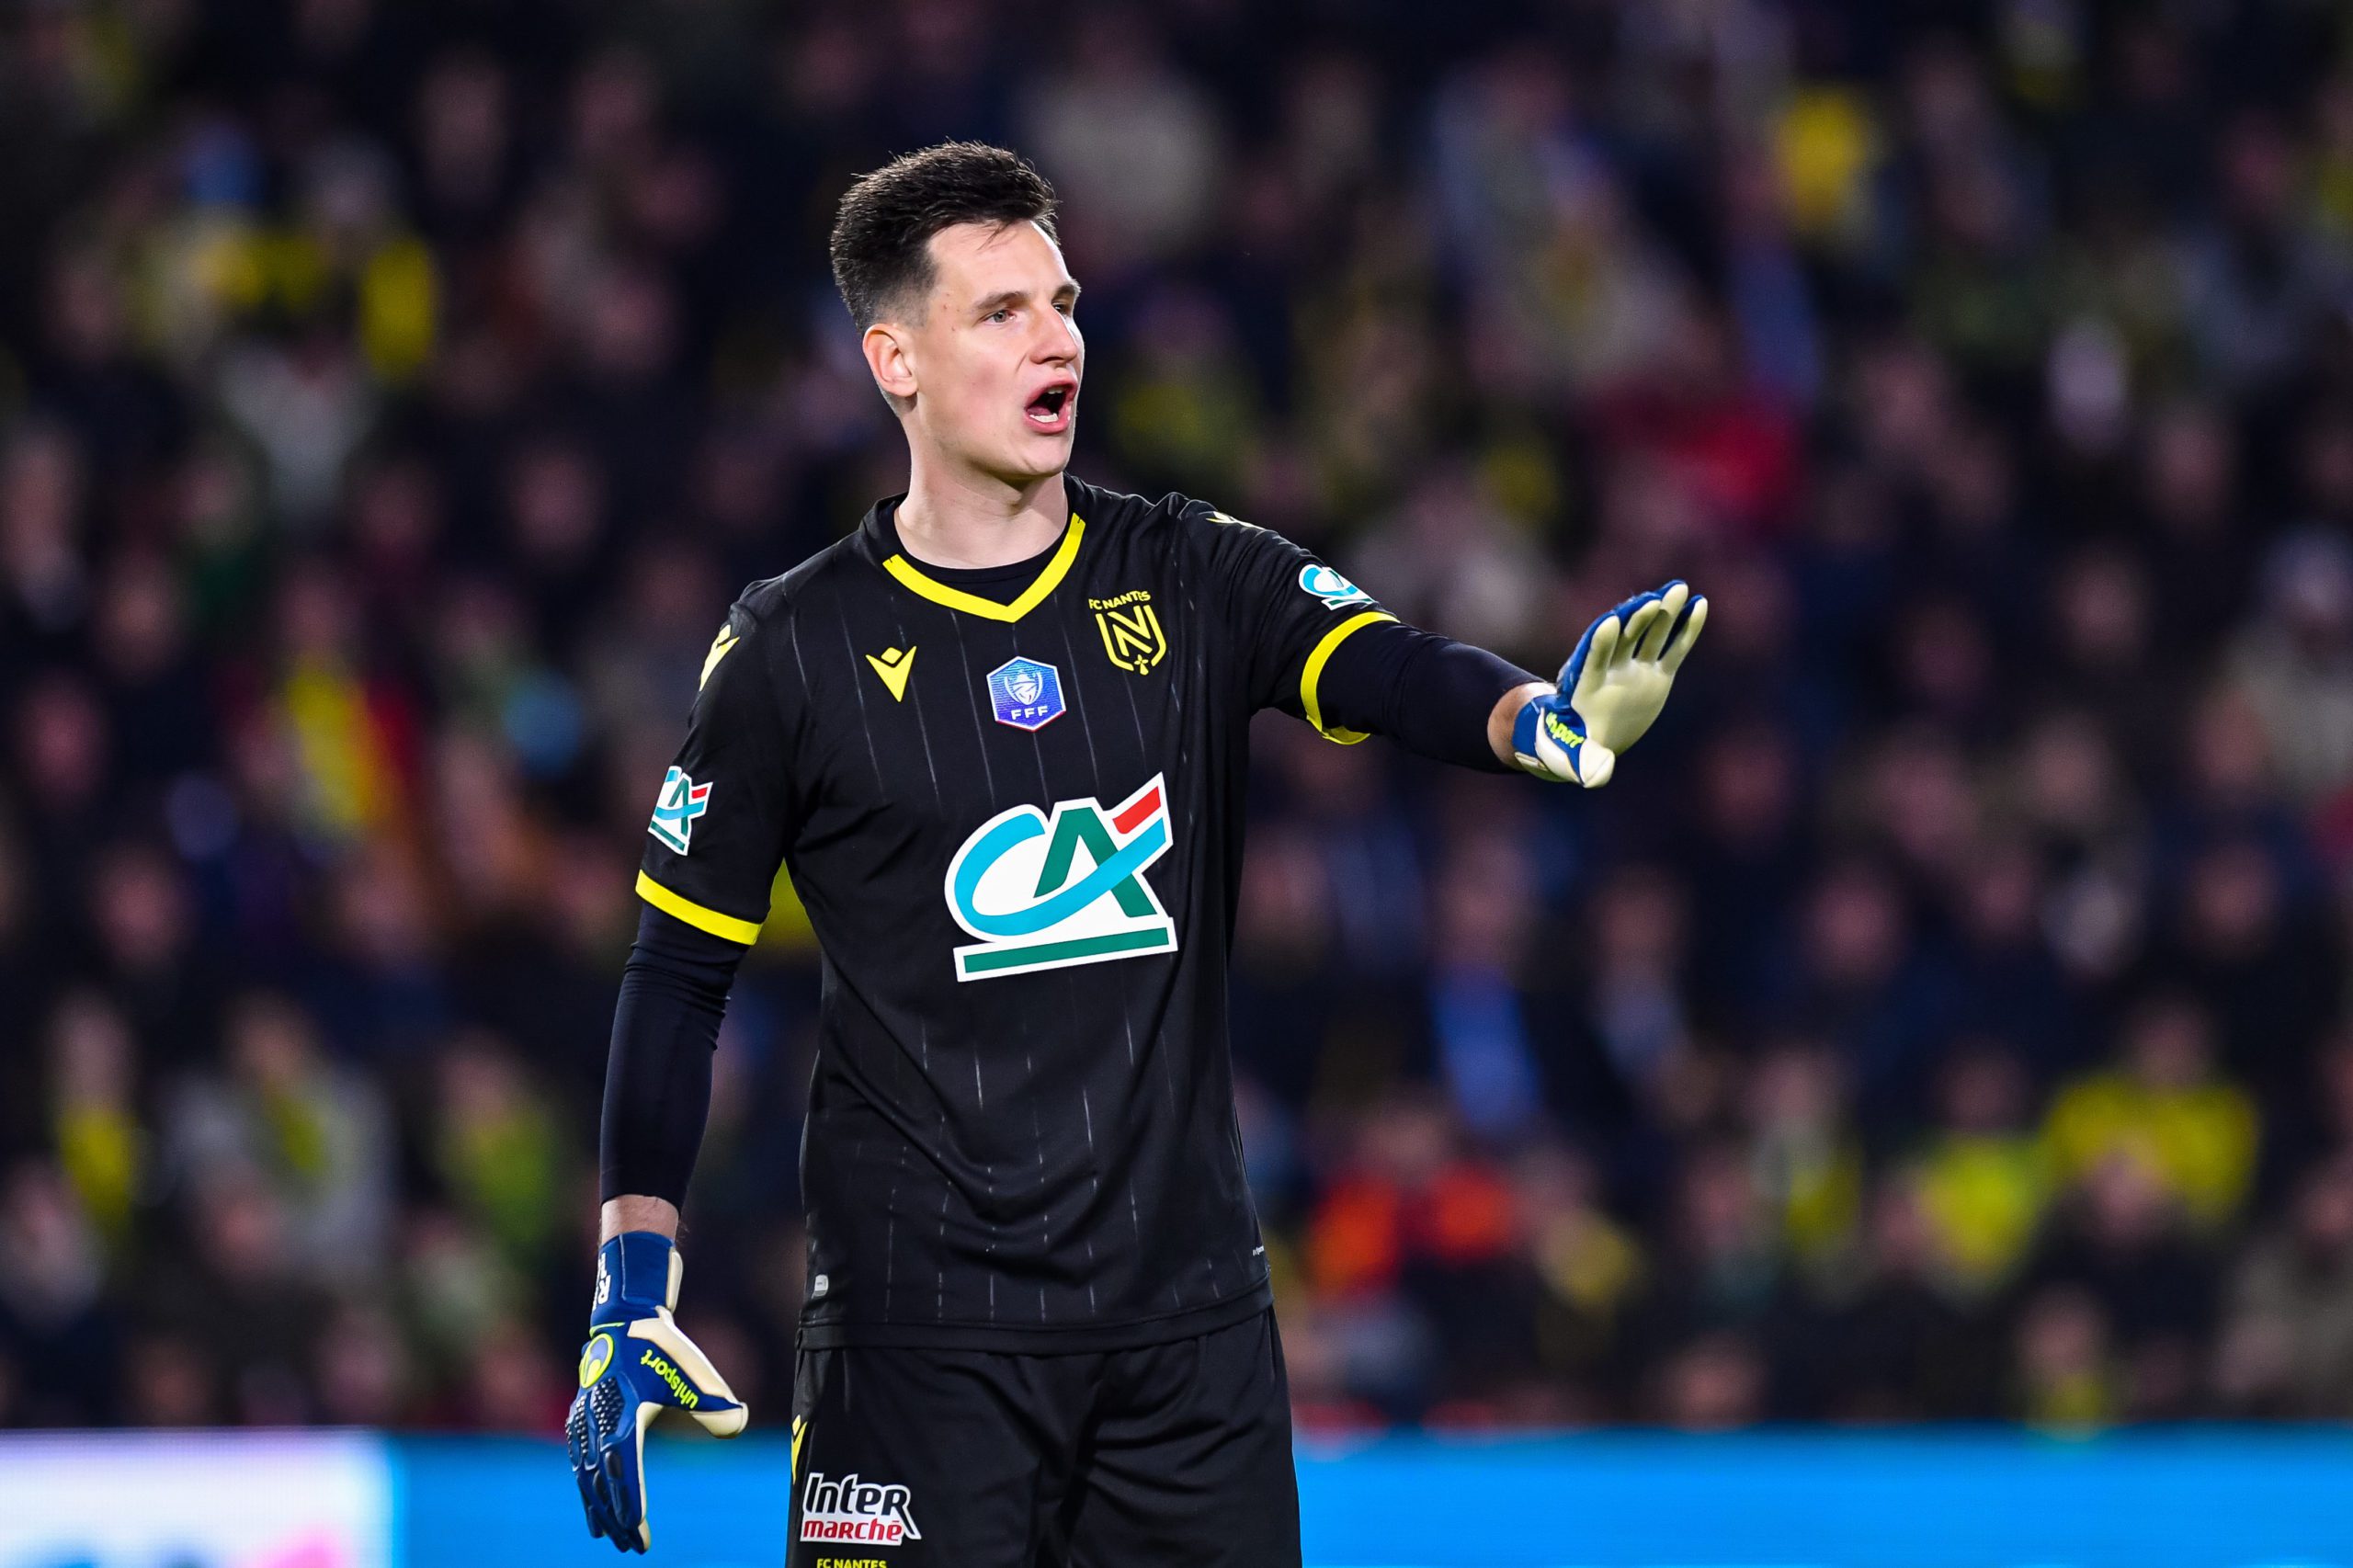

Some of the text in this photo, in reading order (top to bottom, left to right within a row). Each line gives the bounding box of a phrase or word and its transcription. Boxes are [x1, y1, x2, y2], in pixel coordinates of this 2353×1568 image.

[1011, 705, 1048, 721] FFF
[954, 806, 1166, 937] CA
[641, 1349, 699, 1409] uhlsport
[816, 1558, 887, 1568] FC NANTES
